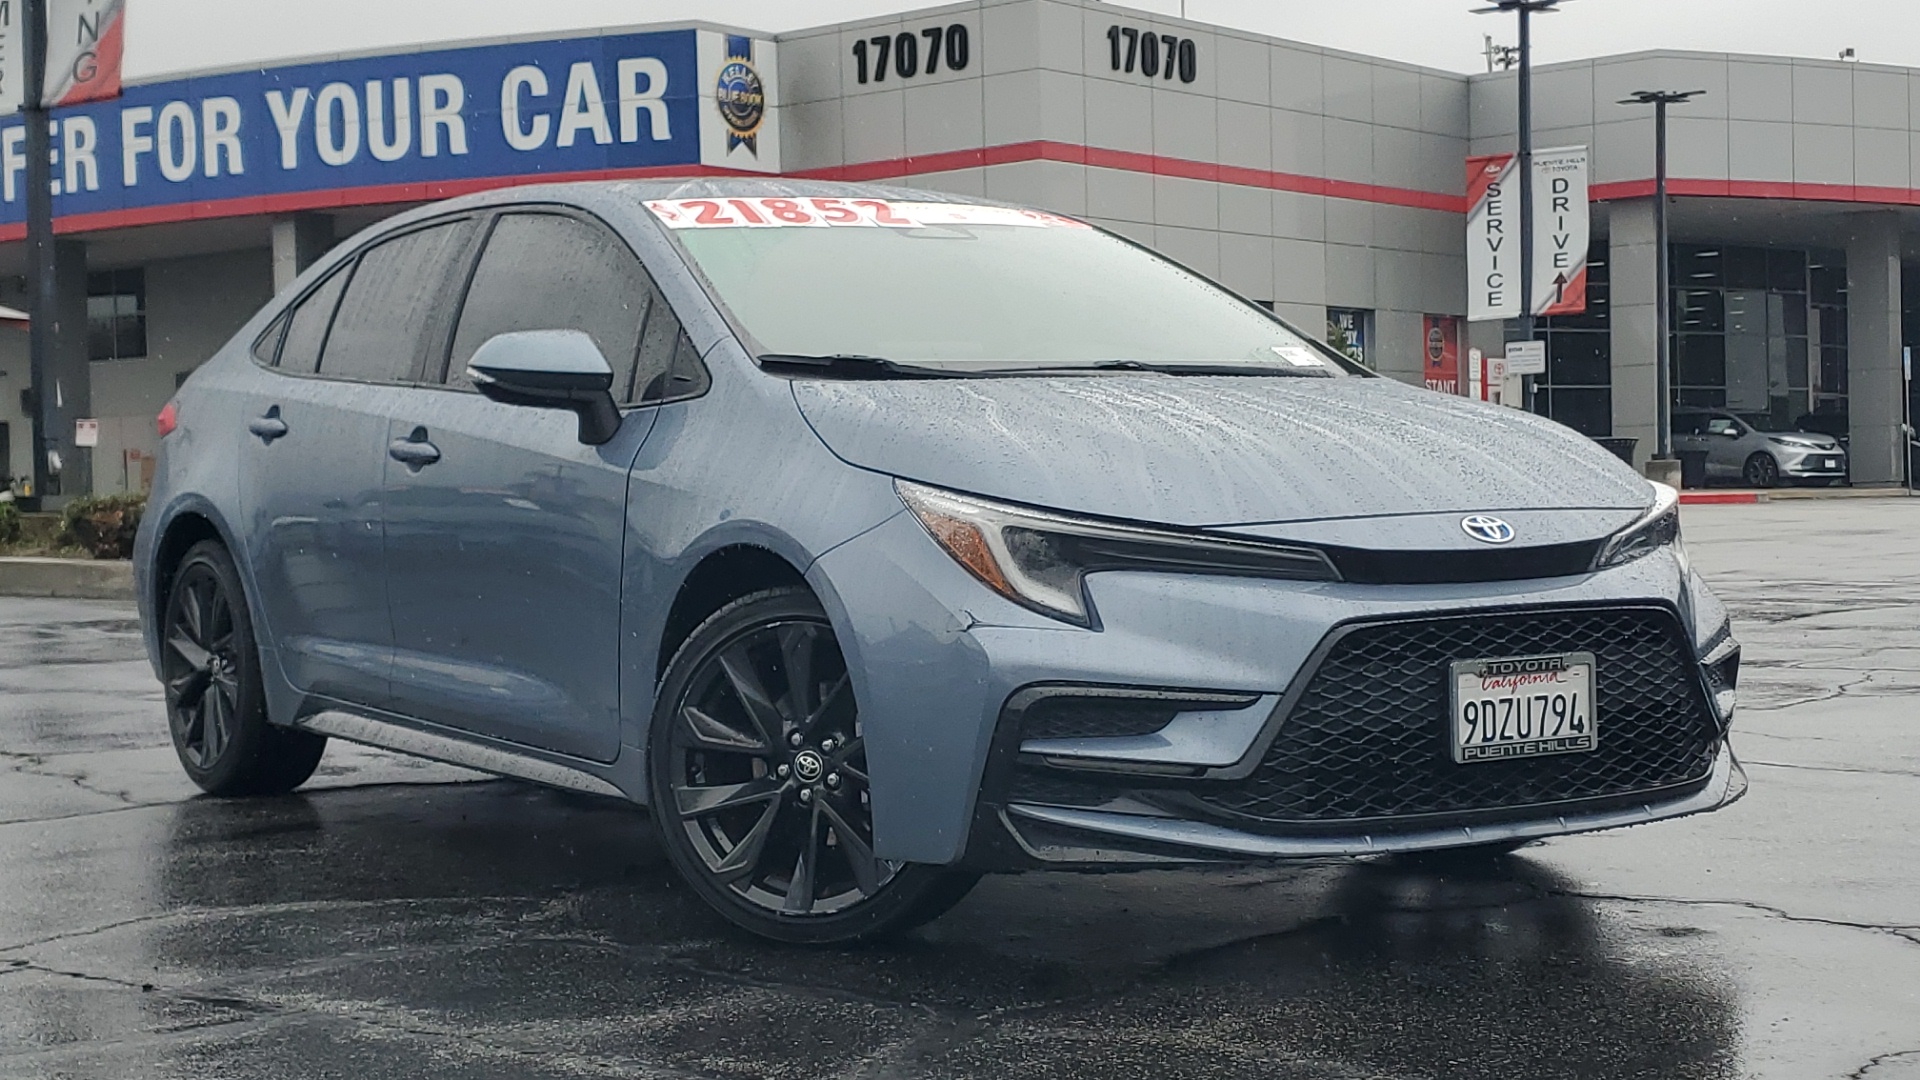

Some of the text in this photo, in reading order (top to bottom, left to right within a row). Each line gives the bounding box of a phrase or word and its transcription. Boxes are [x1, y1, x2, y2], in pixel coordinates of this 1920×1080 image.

[73, 0, 99, 82] NG
[852, 23, 969, 84] 17070
[1107, 25, 1196, 84] 17070
[121, 96, 244, 187] FOR
[265, 73, 469, 171] YOUR
[501, 57, 671, 152] CAR
[1486, 182, 1504, 307] SERVICE
[1552, 178, 1569, 269] DRIVE
[1481, 672, 1567, 695] California
[1490, 658, 1562, 674] TOYOTA
[1463, 692, 1585, 745] 9DZU794
[1464, 737, 1590, 760] PUENTE HILLS
